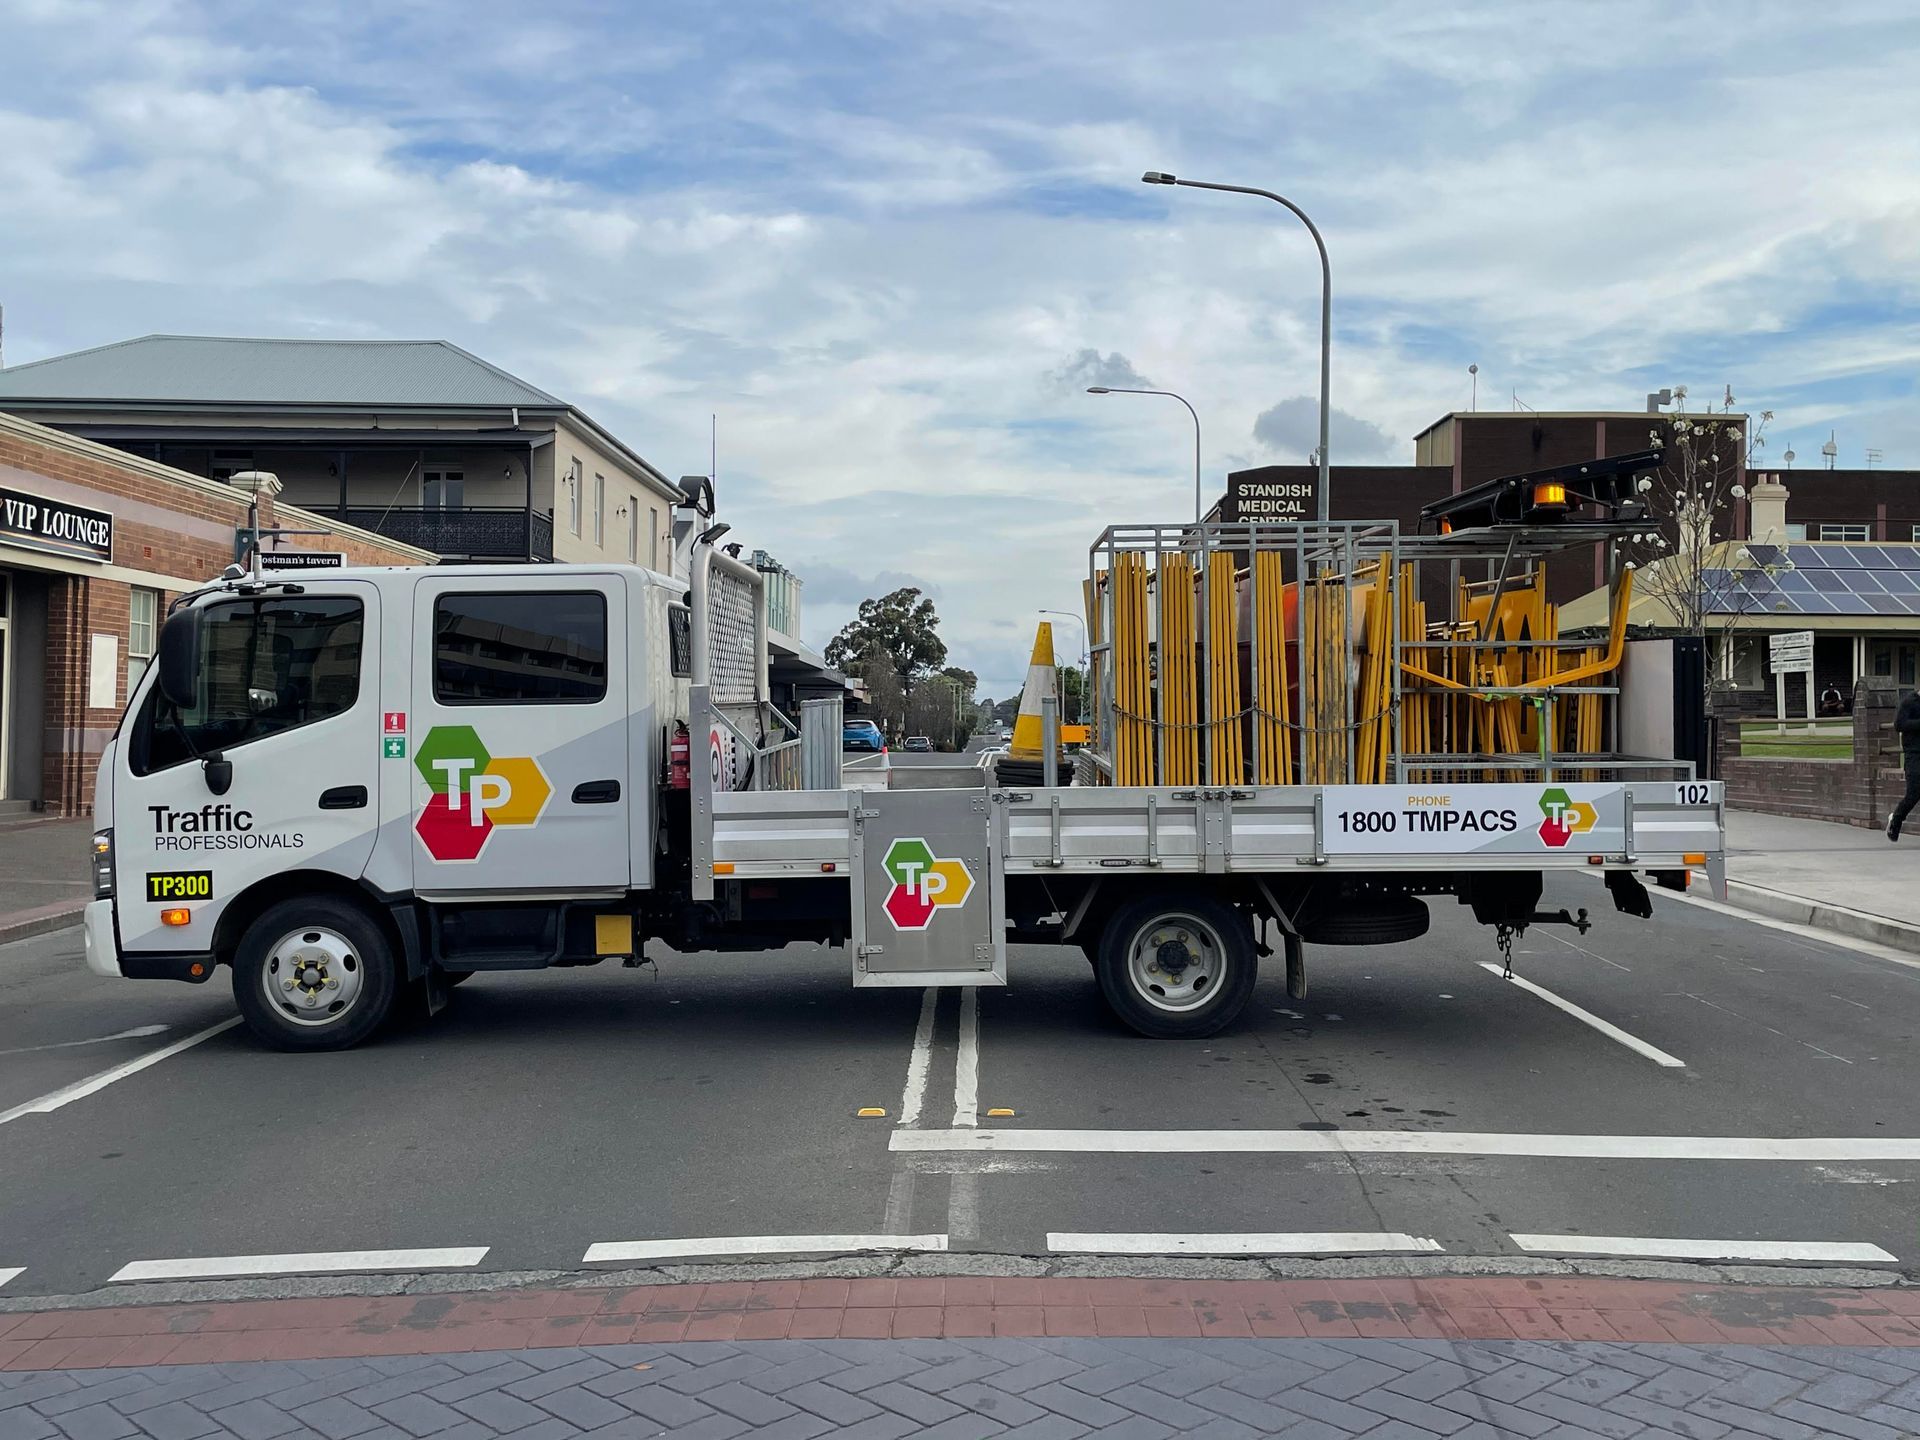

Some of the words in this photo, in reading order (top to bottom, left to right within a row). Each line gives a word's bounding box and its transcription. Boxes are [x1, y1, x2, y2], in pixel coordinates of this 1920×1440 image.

[1238, 484, 1312, 497] STANDISH
[1238, 500, 1306, 513] MEDICAL
[5, 498, 37, 531] VIP
[41, 507, 109, 547] LOUNGE
[262, 555, 304, 565] ostman's
[306, 556, 339, 565] tavern
[432, 758, 512, 827] TP
[1407, 796, 1451, 806] PHONE
[1677, 784, 1709, 805] 102
[148, 804, 253, 833] Traffic
[1338, 811, 1397, 833] 1800
[1402, 809, 1517, 832] TMPACS
[1546, 802, 1581, 832] TP
[155, 833, 304, 850] PROFESSIONALS
[150, 875, 209, 897] TP300
[896, 862, 948, 906] TP
